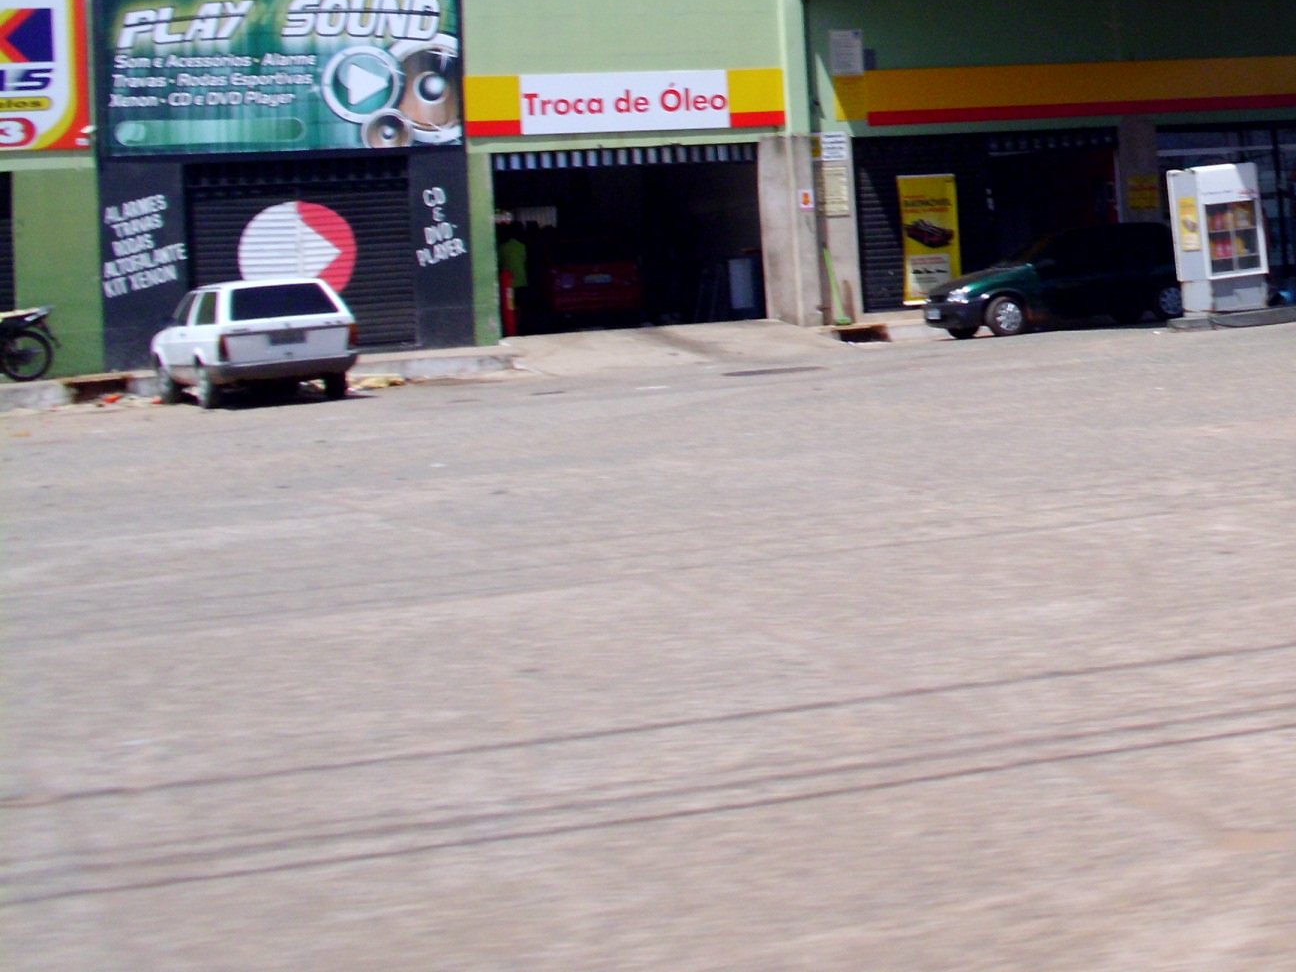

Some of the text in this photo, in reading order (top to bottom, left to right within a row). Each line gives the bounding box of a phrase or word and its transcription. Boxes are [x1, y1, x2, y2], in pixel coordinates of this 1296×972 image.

[117, 0, 256, 49] PLAY
[112, 72, 313, 88] Travas Rodas Esportivas
[168, 92, 193, 106] CD
[205, 91, 243, 106] DVD
[245, 90, 296, 107] Player
[523, 82, 728, 116] Troca de Óleo
[423, 186, 446, 207] CD
[424, 222, 454, 245] DVD
[416, 237, 467, 267] PLAYER
[127, 264, 178, 291] XENON
